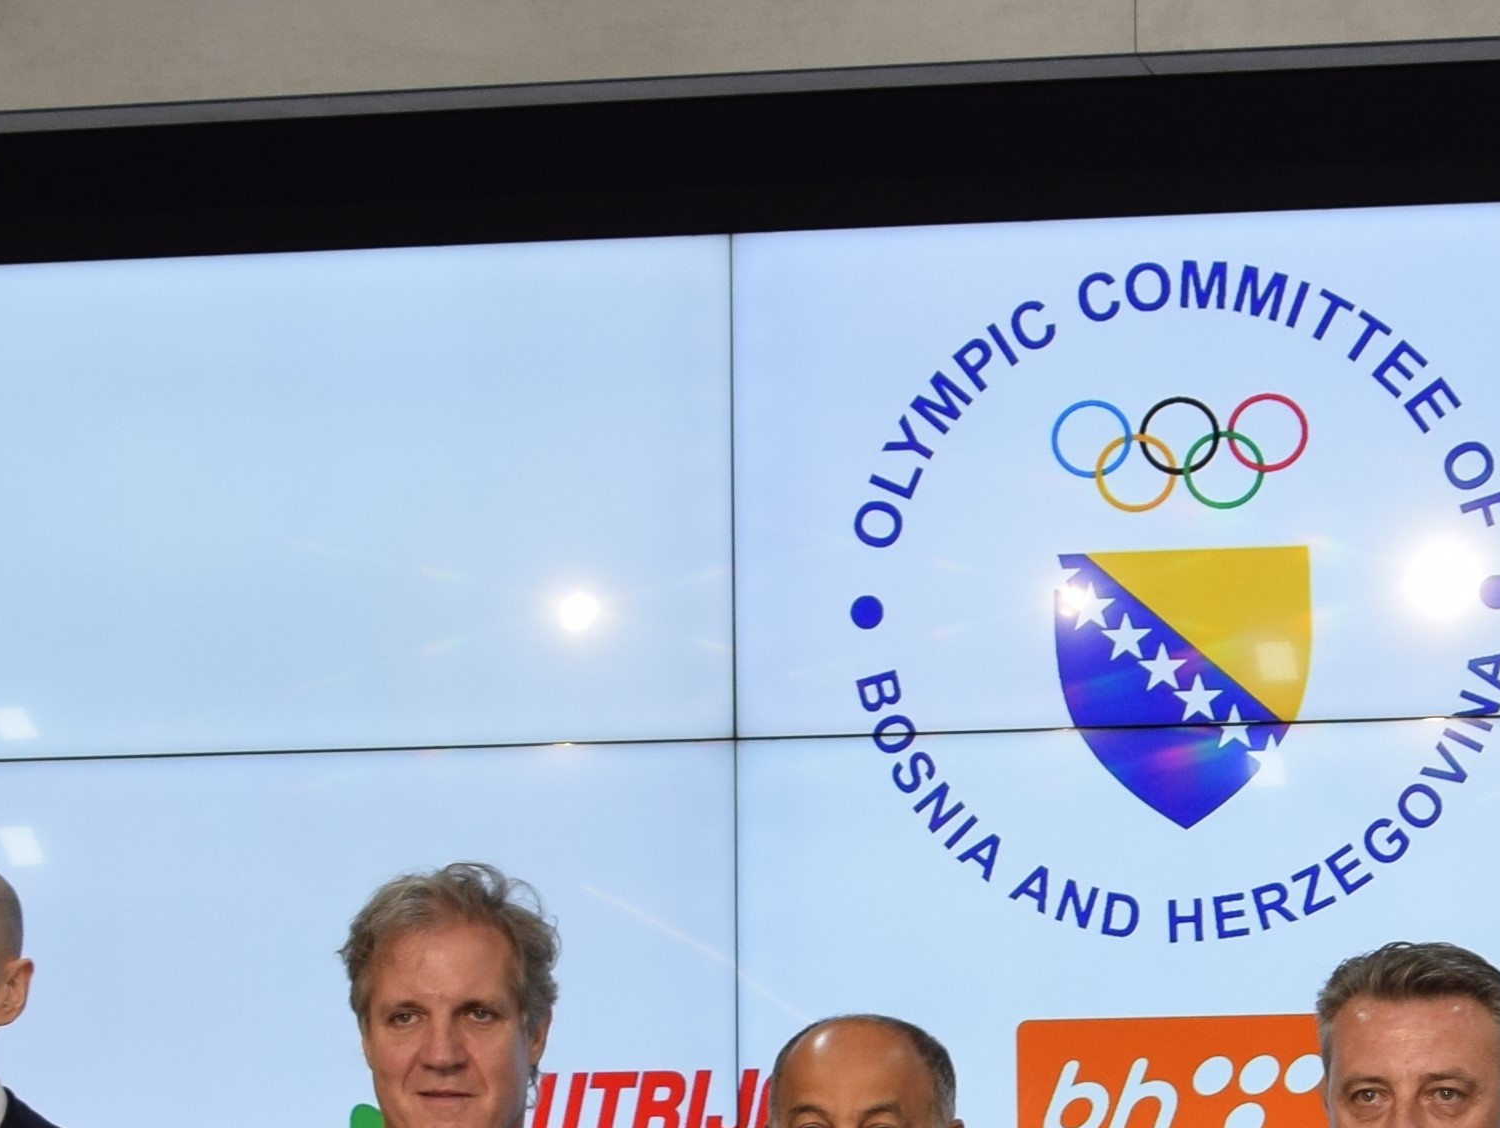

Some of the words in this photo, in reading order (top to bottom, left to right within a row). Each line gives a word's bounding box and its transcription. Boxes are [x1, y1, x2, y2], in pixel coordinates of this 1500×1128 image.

[854, 300, 1056, 548] OLYMPIC
[1078, 259, 1462, 434] COMMITTEE
[856, 669, 1002, 883] BOSNIA
[1008, 864, 1140, 938] AND
